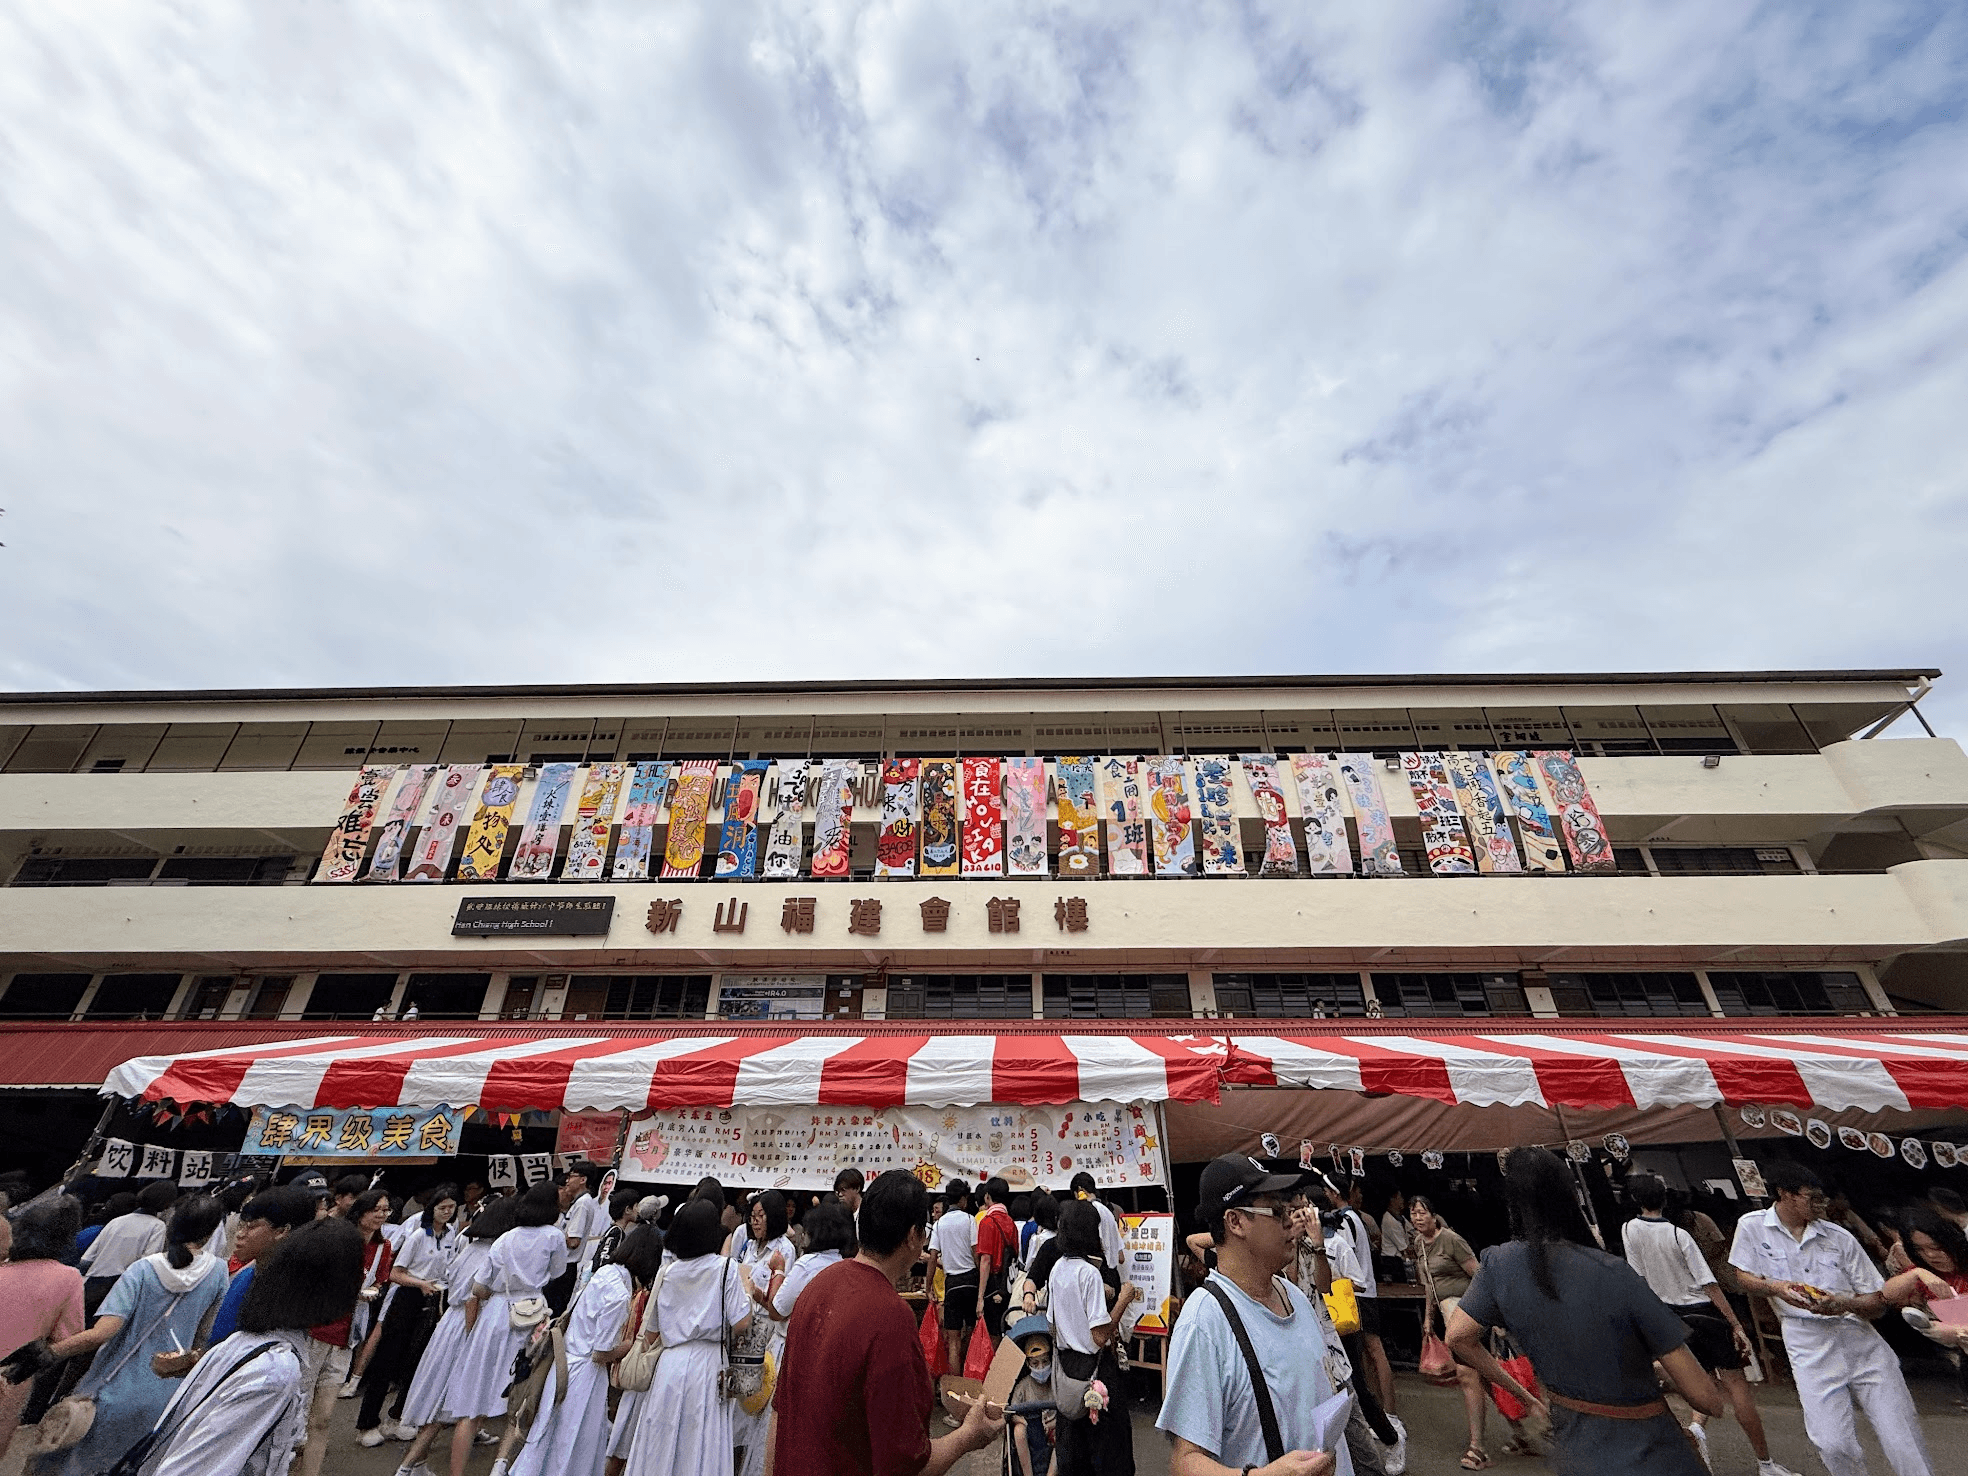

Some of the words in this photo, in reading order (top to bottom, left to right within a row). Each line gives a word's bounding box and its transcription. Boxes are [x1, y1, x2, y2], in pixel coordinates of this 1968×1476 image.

[645, 896, 1088, 934] 新山福建會館樓
[1083, 1111, 1106, 1122] 小吃
[259, 1112, 453, 1150] 肆界级美食
[714, 1127, 730, 1136] RM
[731, 1128, 741, 1141] 5
[834, 1129, 839, 1137] 3
[1030, 1128, 1038, 1139] 5
[1113, 1126, 1120, 1136] 5
[1031, 1140, 1038, 1151] 5
[1074, 1142, 1106, 1150] Waffle
[1115, 1140, 1122, 1150] 3
[107, 1144, 209, 1179] 饮料站
[711, 1151, 727, 1159] RM
[731, 1152, 748, 1166] 10
[1109, 1154, 1125, 1165] 10
[1119, 1172, 1127, 1183] 5
